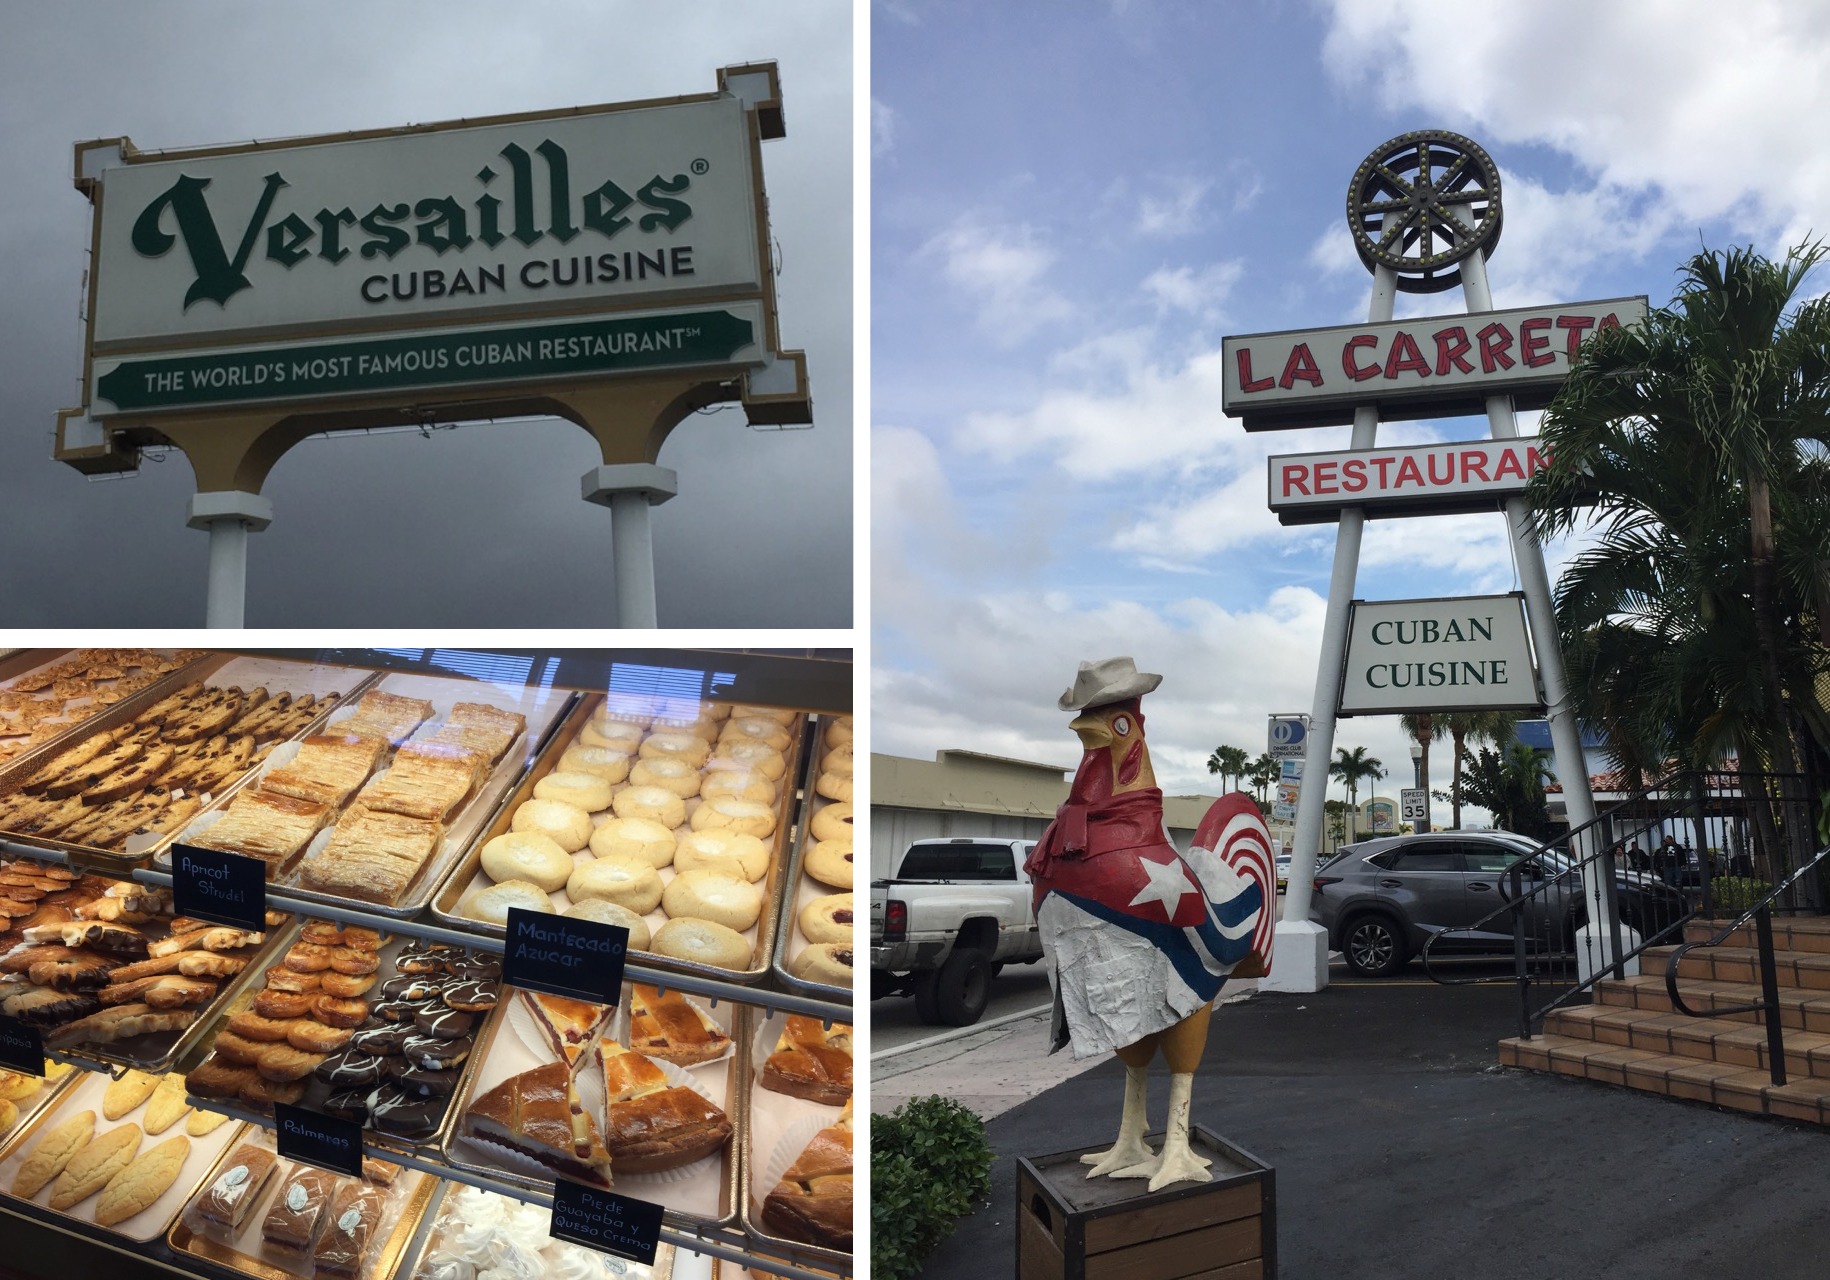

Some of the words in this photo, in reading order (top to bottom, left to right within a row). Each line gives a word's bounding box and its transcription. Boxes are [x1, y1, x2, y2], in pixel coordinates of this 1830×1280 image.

[360, 263, 507, 304] CUBAN
[520, 246, 696, 289] CUISINE
[144, 371, 185, 393] THE
[191, 362, 286, 388] WORLD'S
[292, 356, 352, 381] MOST
[359, 348, 450, 376] FAMOUS
[455, 341, 533, 368] CUBAN
[539, 327, 686, 360] RESTAURANT
[1236, 342, 1325, 394] LA
[1281, 445, 1576, 498] RESTAURAN
[1371, 616, 1494, 646] CUBAN
[1365, 660, 1509, 689] CUISINE
[1404, 805, 1425, 818] 35
[182, 856, 231, 880] Apricot
[517, 921, 623, 955] Mantecado
[515, 943, 583, 967] Azucar
[555, 1200, 624, 1229] Guayaba
